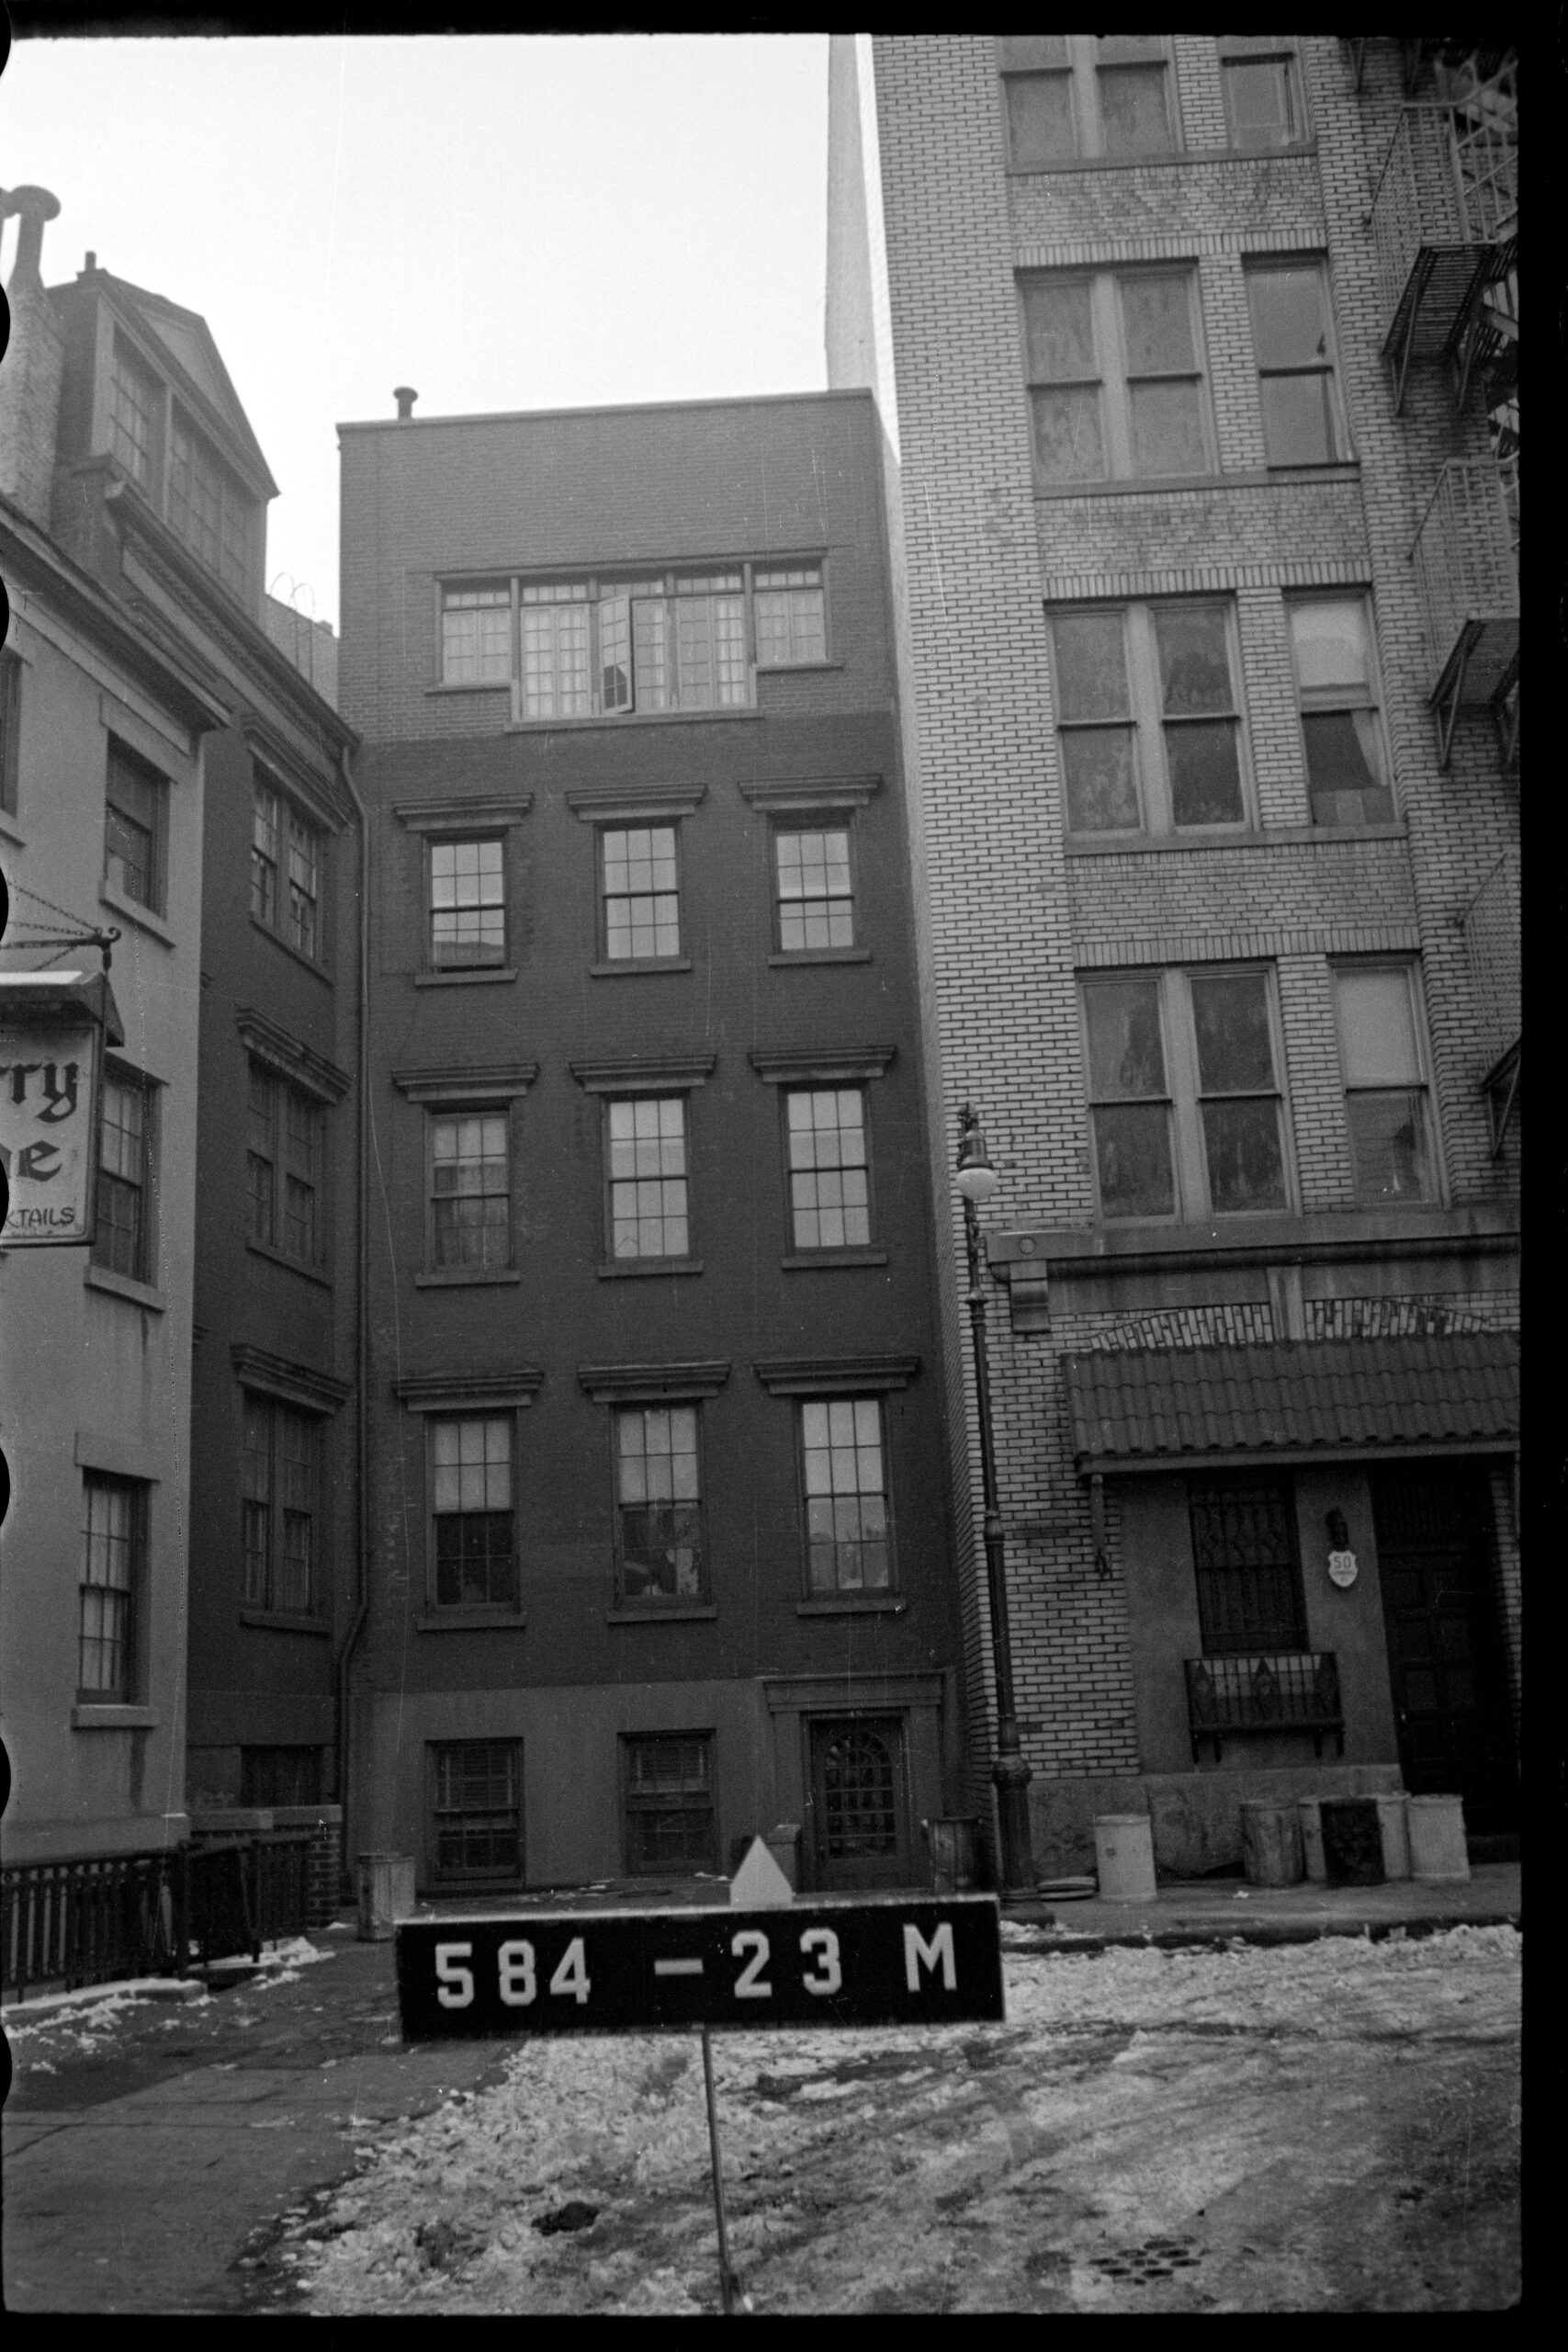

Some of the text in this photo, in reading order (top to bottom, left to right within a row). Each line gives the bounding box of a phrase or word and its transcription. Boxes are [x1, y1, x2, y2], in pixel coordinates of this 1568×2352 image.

[0, 1061, 79, 1124] ry
[1334, 1555, 1351, 1569] 50
[434, 1938, 591, 2008] 584
[903, 1923, 957, 1992] M
